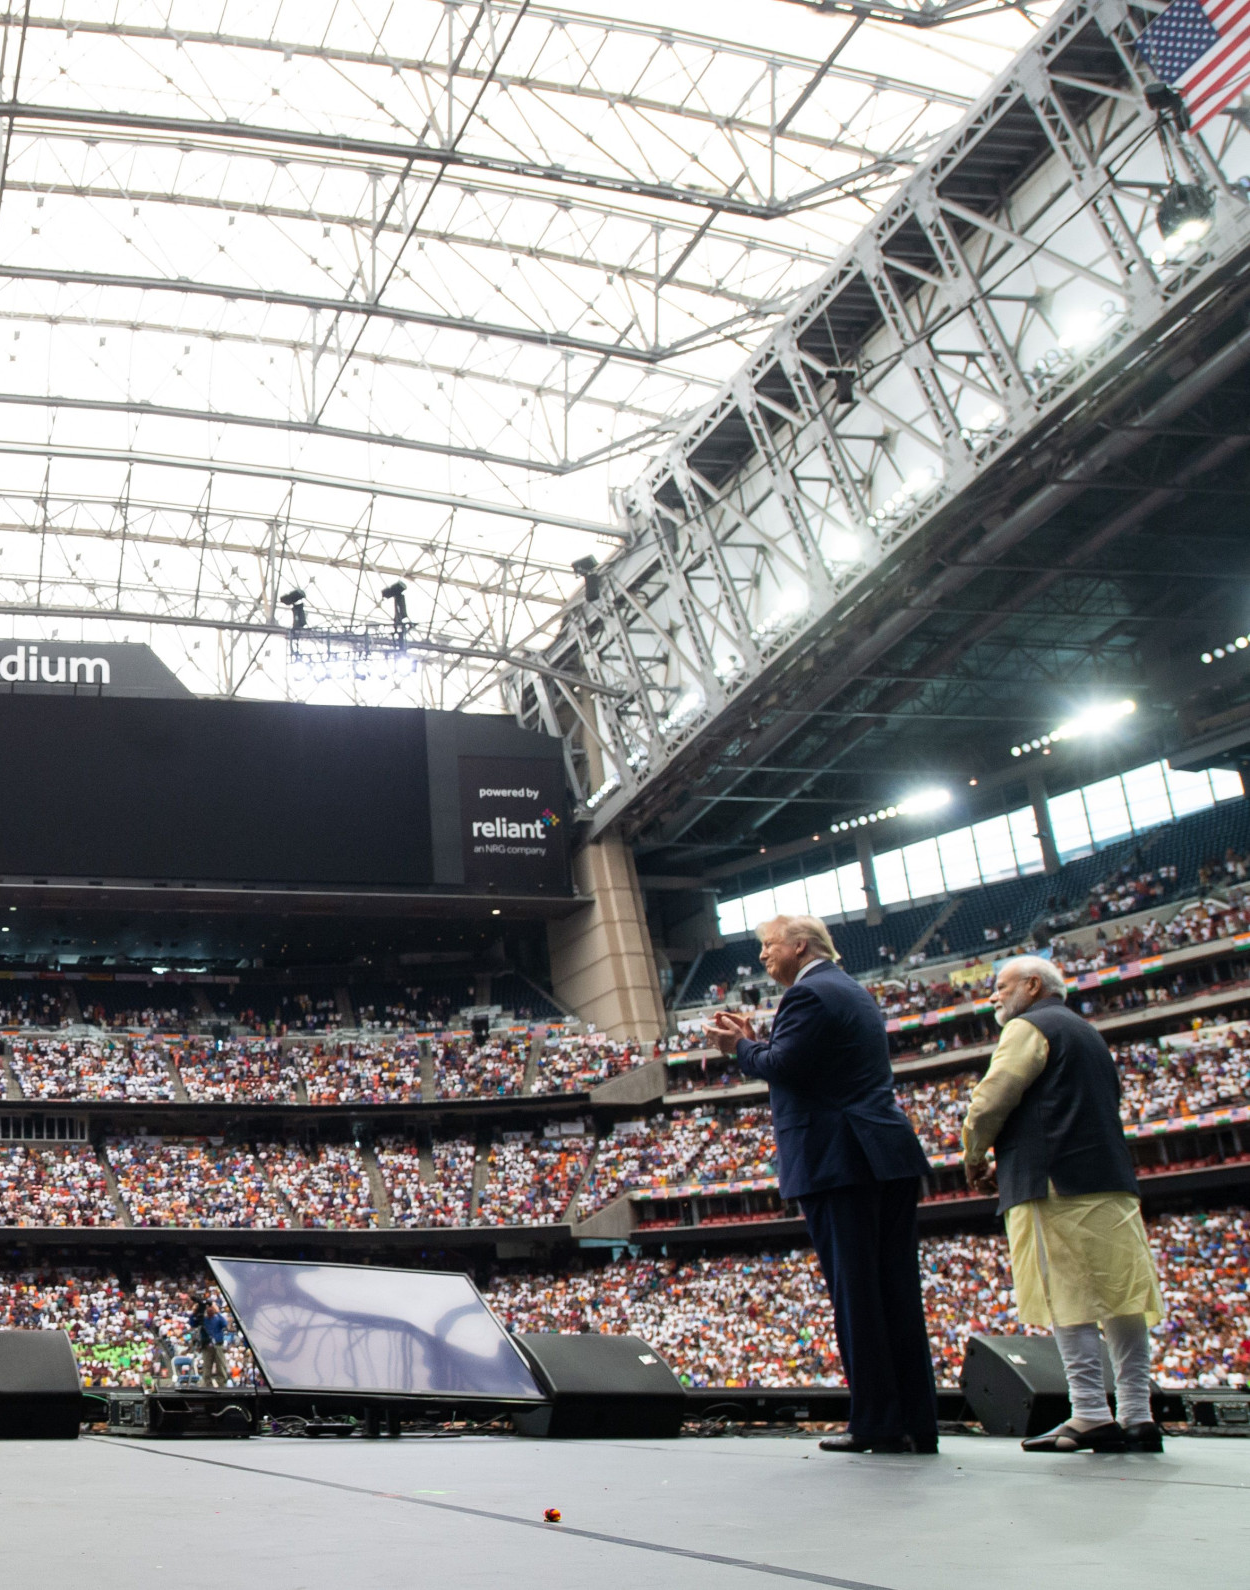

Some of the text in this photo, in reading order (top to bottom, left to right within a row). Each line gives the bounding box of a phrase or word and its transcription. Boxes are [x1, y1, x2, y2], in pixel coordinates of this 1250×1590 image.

[479, 788, 540, 800] powered by
[472, 817, 547, 839] reliant
[473, 844, 547, 857] an NRG company
